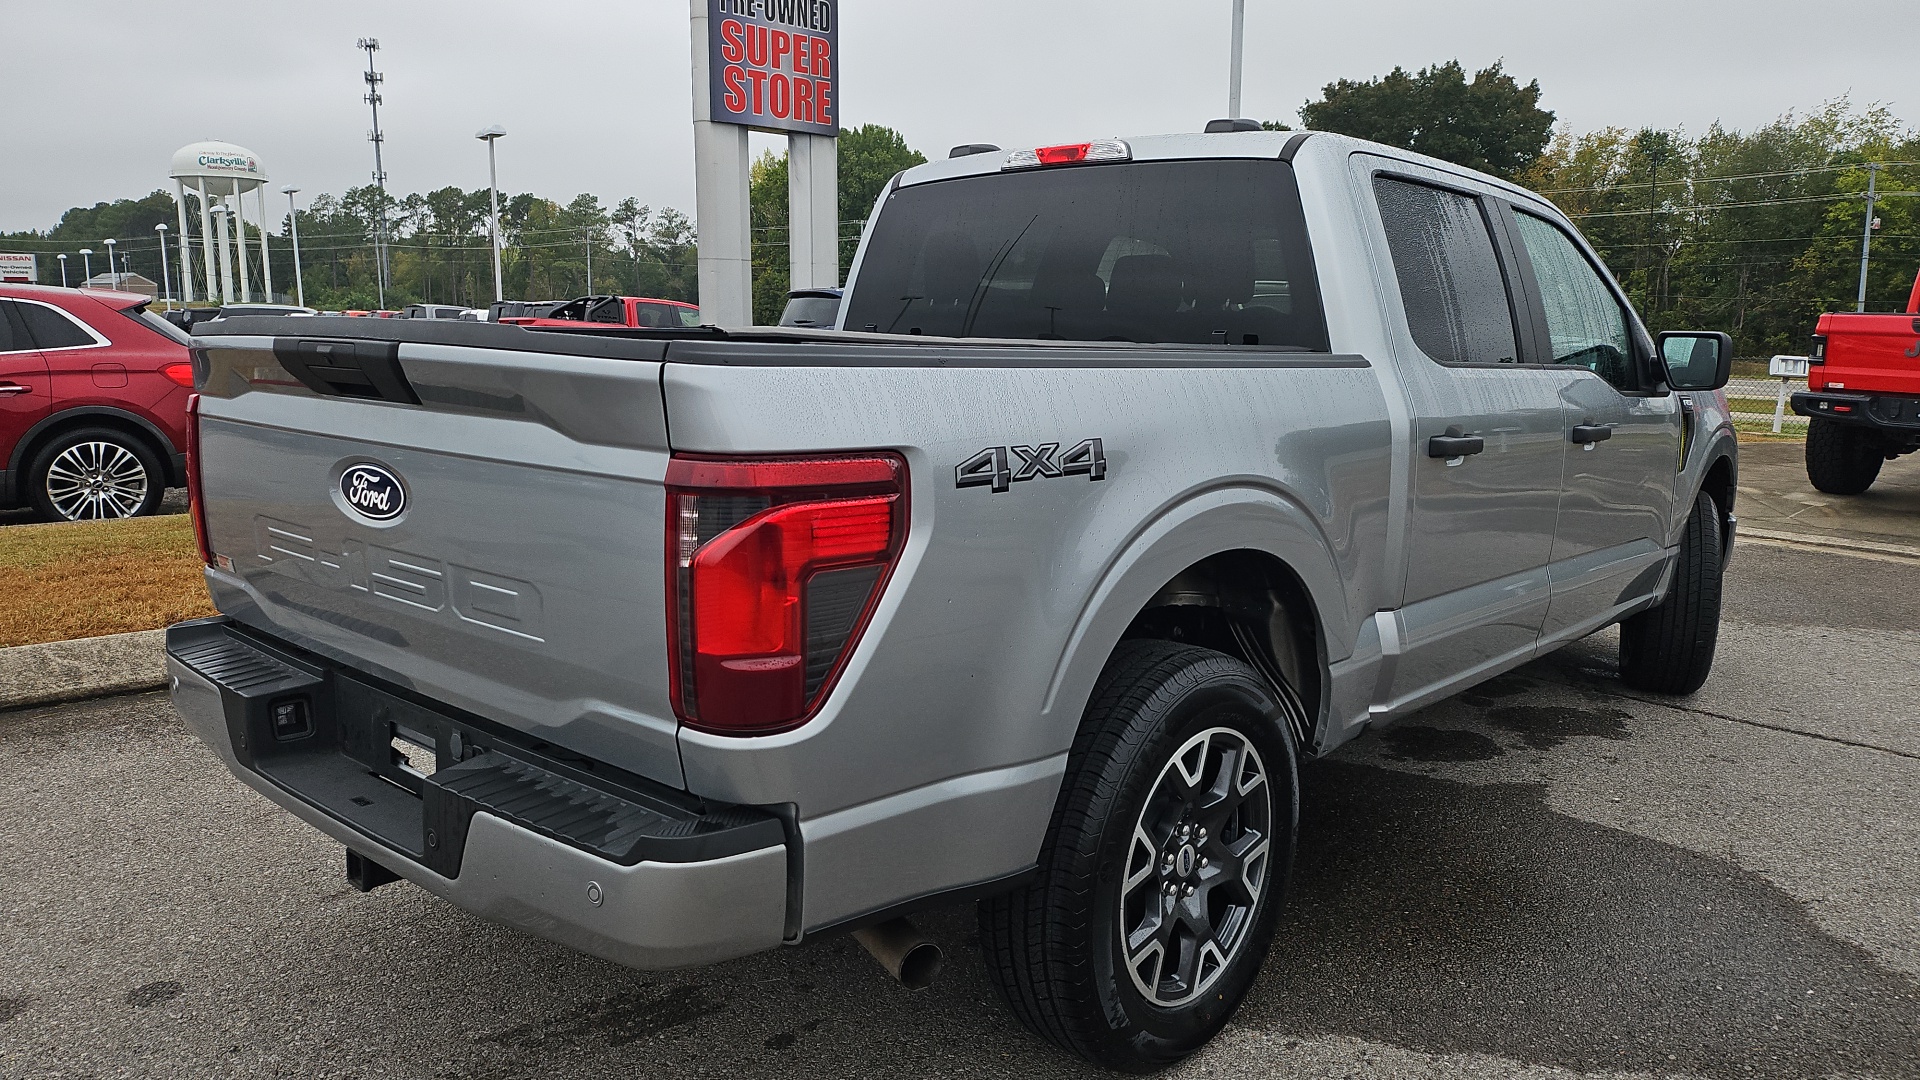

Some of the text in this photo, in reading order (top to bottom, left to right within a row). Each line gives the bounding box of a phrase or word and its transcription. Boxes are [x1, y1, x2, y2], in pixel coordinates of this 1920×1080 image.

[721, 19, 831, 78] SUPER
[723, 64, 832, 125] STORE
[198, 156, 247, 167] Clarksville
[350, 470, 391, 511] Ford
[254, 513, 546, 643] F-150
